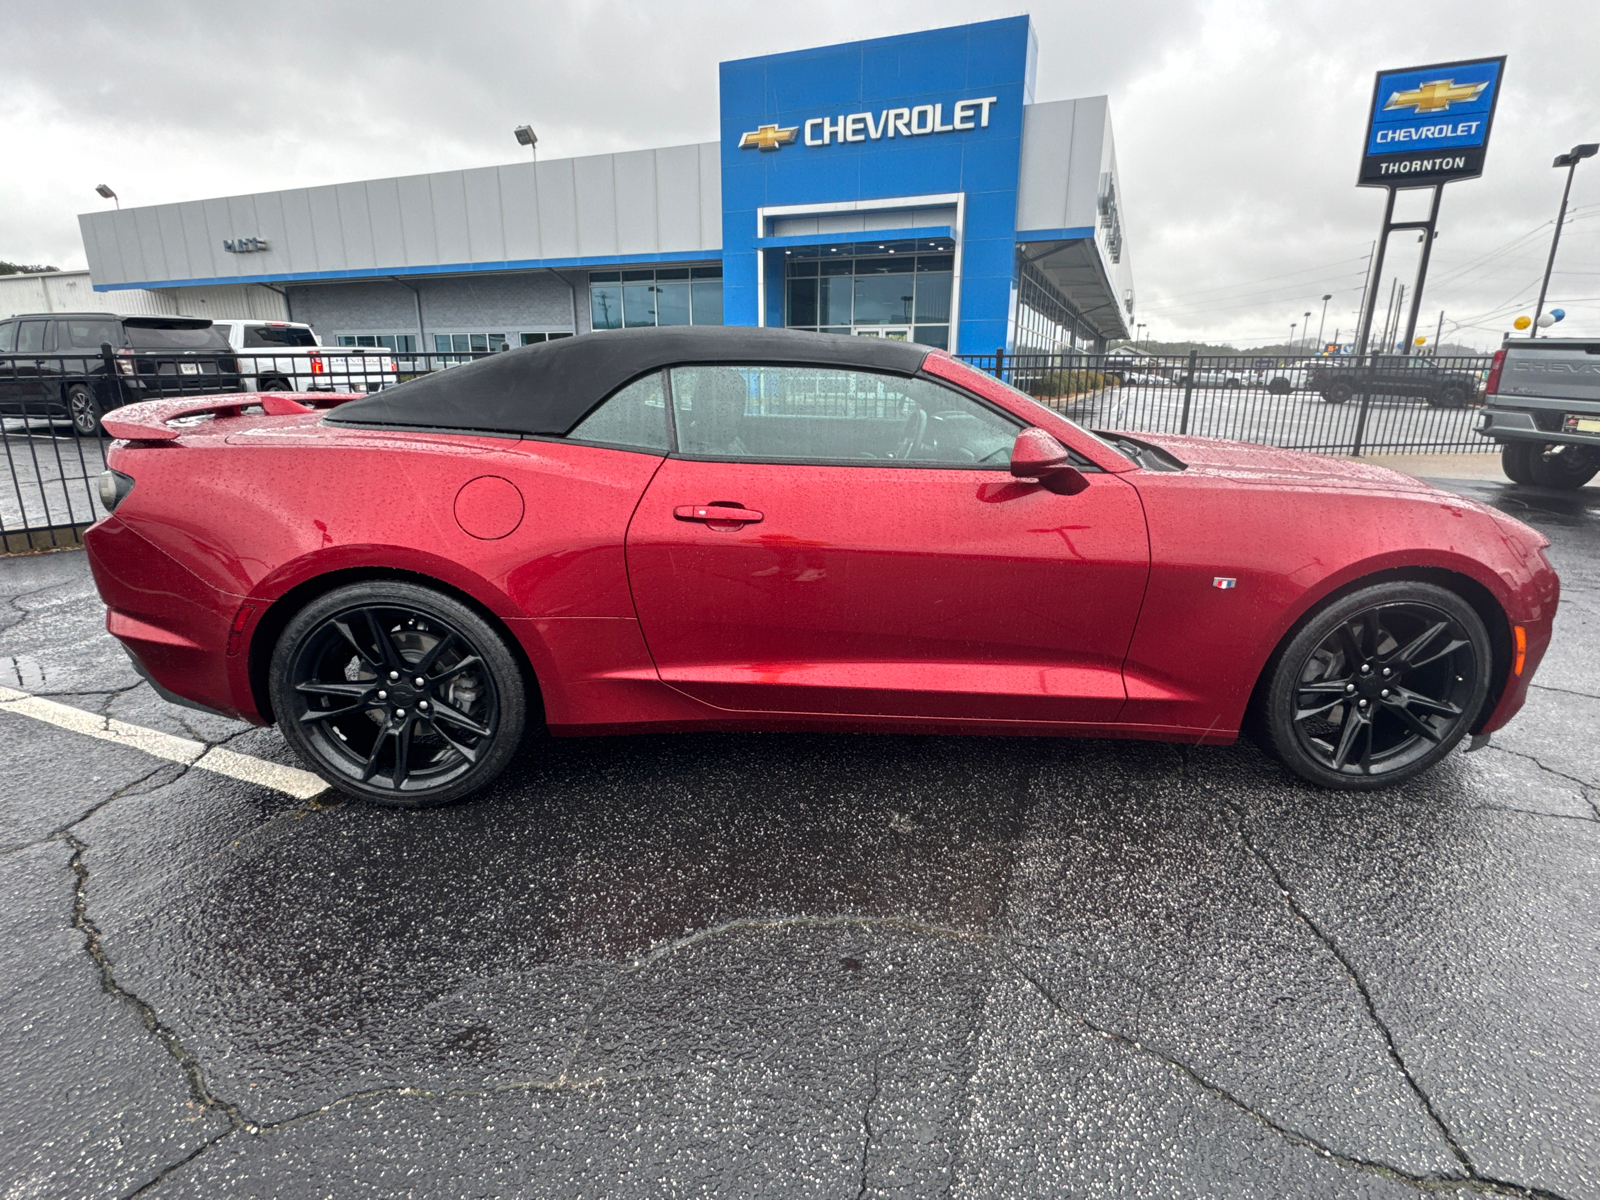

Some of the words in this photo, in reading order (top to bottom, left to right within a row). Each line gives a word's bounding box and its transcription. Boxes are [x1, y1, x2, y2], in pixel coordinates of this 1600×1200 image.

[804, 96, 997, 146] CHEVROLET
[1376, 121, 1481, 143] CHEVROLET
[1380, 156, 1466, 175] THORNTON
